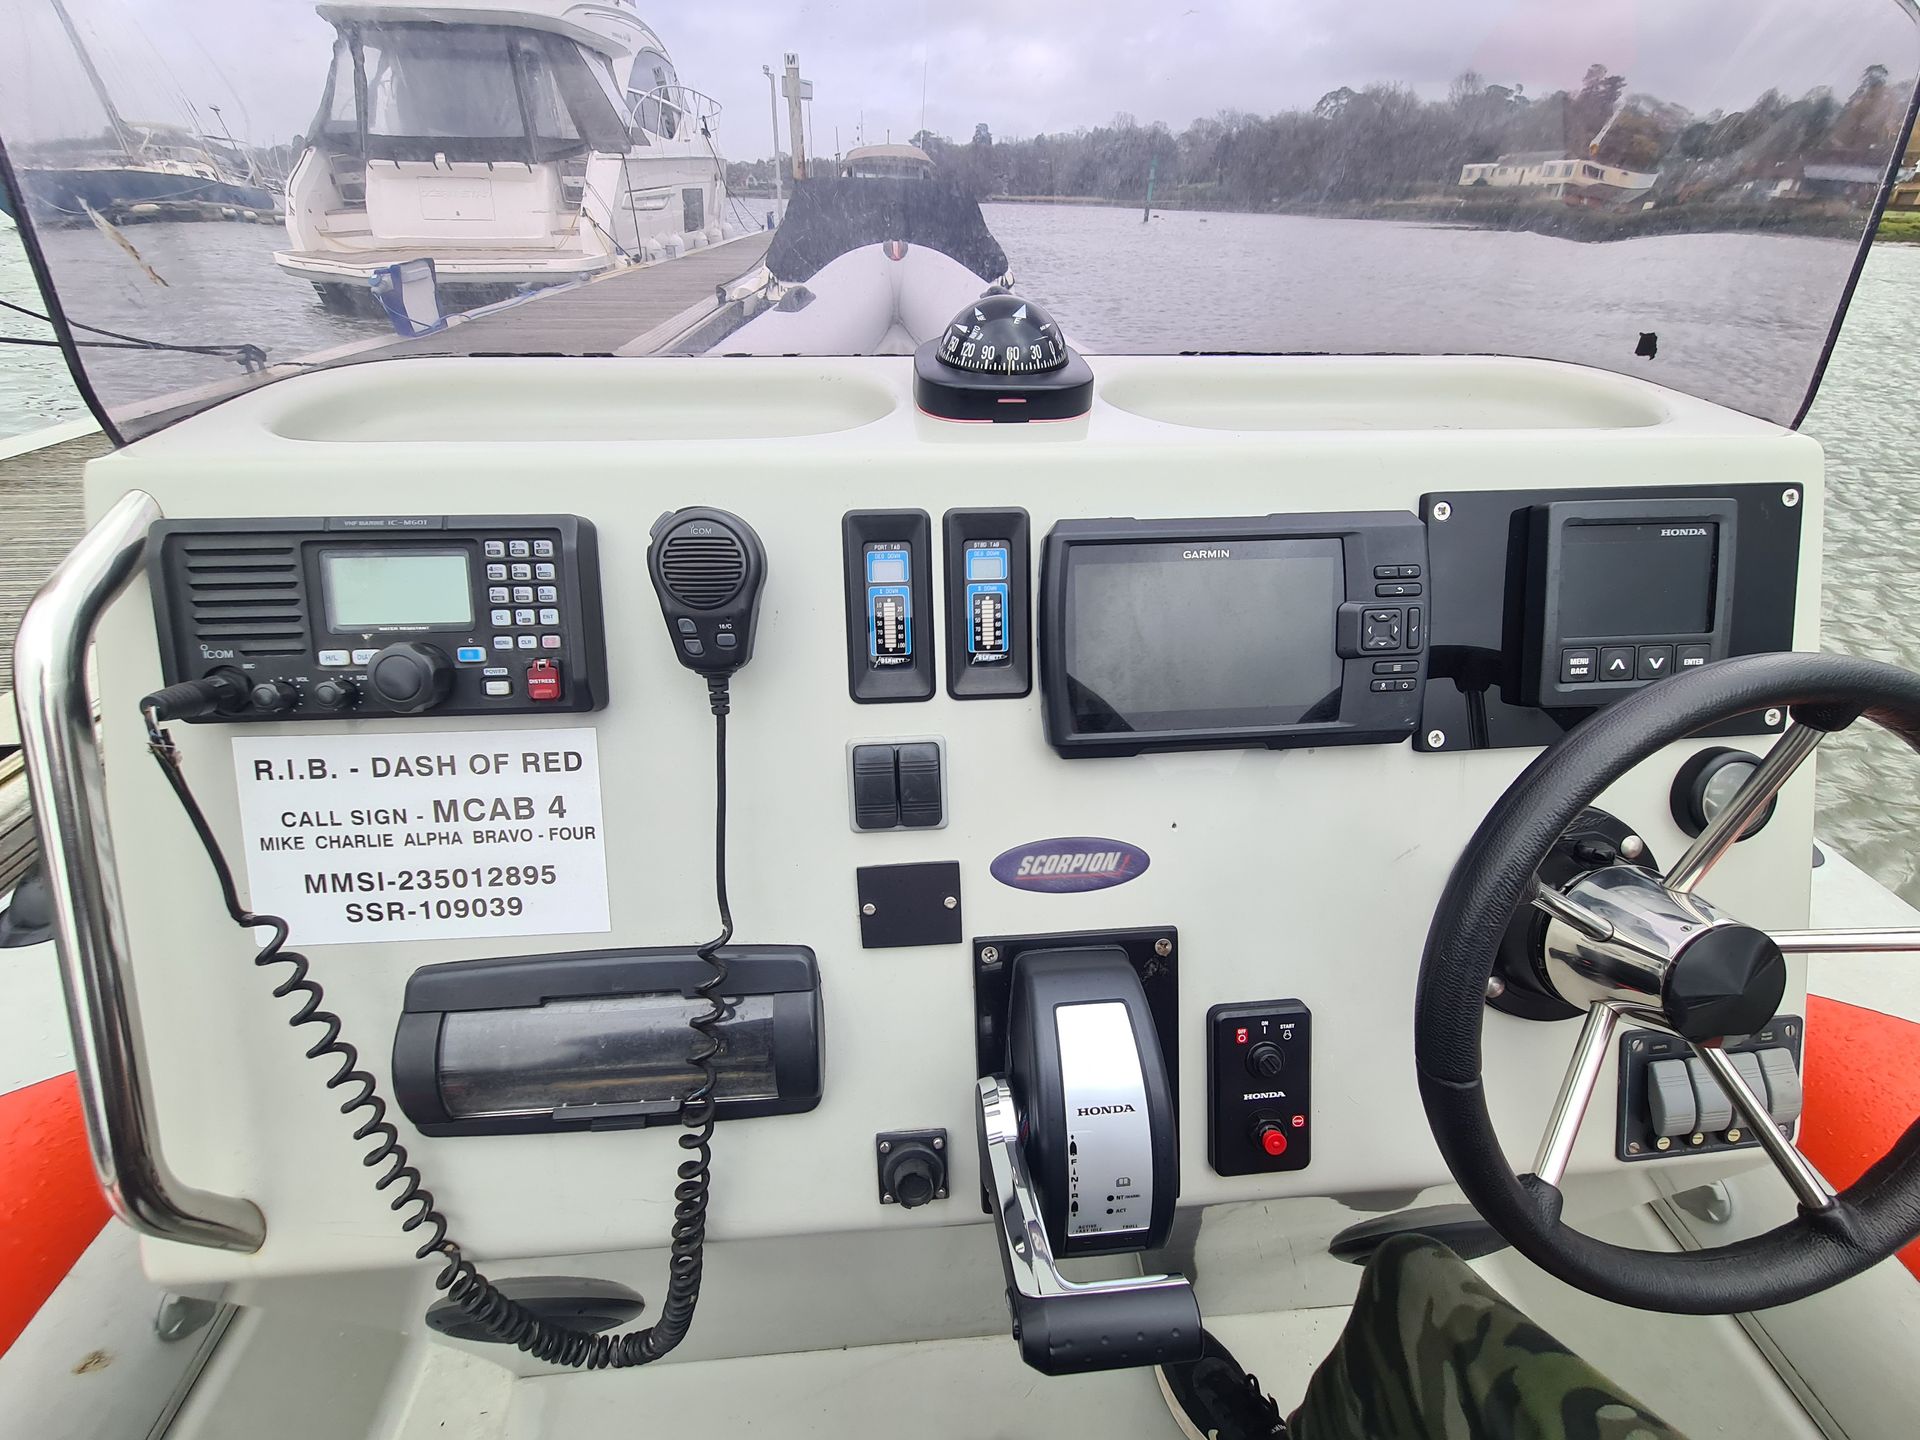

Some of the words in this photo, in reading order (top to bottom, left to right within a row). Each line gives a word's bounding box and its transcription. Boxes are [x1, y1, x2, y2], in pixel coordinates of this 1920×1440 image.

[787, 54, 796, 65] M
[960, 341, 976, 358] 120
[981, 345, 996, 360] 90
[1006, 346, 1020, 360] 60
[1030, 344, 1042, 360] 30
[1660, 528, 1708, 537] HONDA
[1182, 549, 1230, 559] GARMIN
[1569, 657, 1589, 665] MENU
[1683, 658, 1704, 666] ENTER
[1570, 667, 1588, 675] BACK
[254, 758, 338, 781] R.I.B.
[371, 755, 457, 779] DASH
[468, 752, 510, 775] OF
[522, 751, 583, 773] RED
[281, 809, 343, 828] CALL
[350, 808, 408, 826] SIGN
[432, 796, 536, 824] MCAB
[548, 794, 568, 819] 4
[260, 836, 306, 852] MIKE
[315, 833, 394, 849] CHARLIE
[403, 831, 463, 847] ALPHA
[472, 828, 533, 844] BRAVO
[549, 825, 596, 842] FOUR
[1016, 851, 1122, 876] SCORPION
[304, 864, 557, 894] MMSI-235012895
[345, 896, 524, 923] SSR-109039
[1243, 1091, 1286, 1100] HONDA
[1077, 1104, 1136, 1117] HONDA
